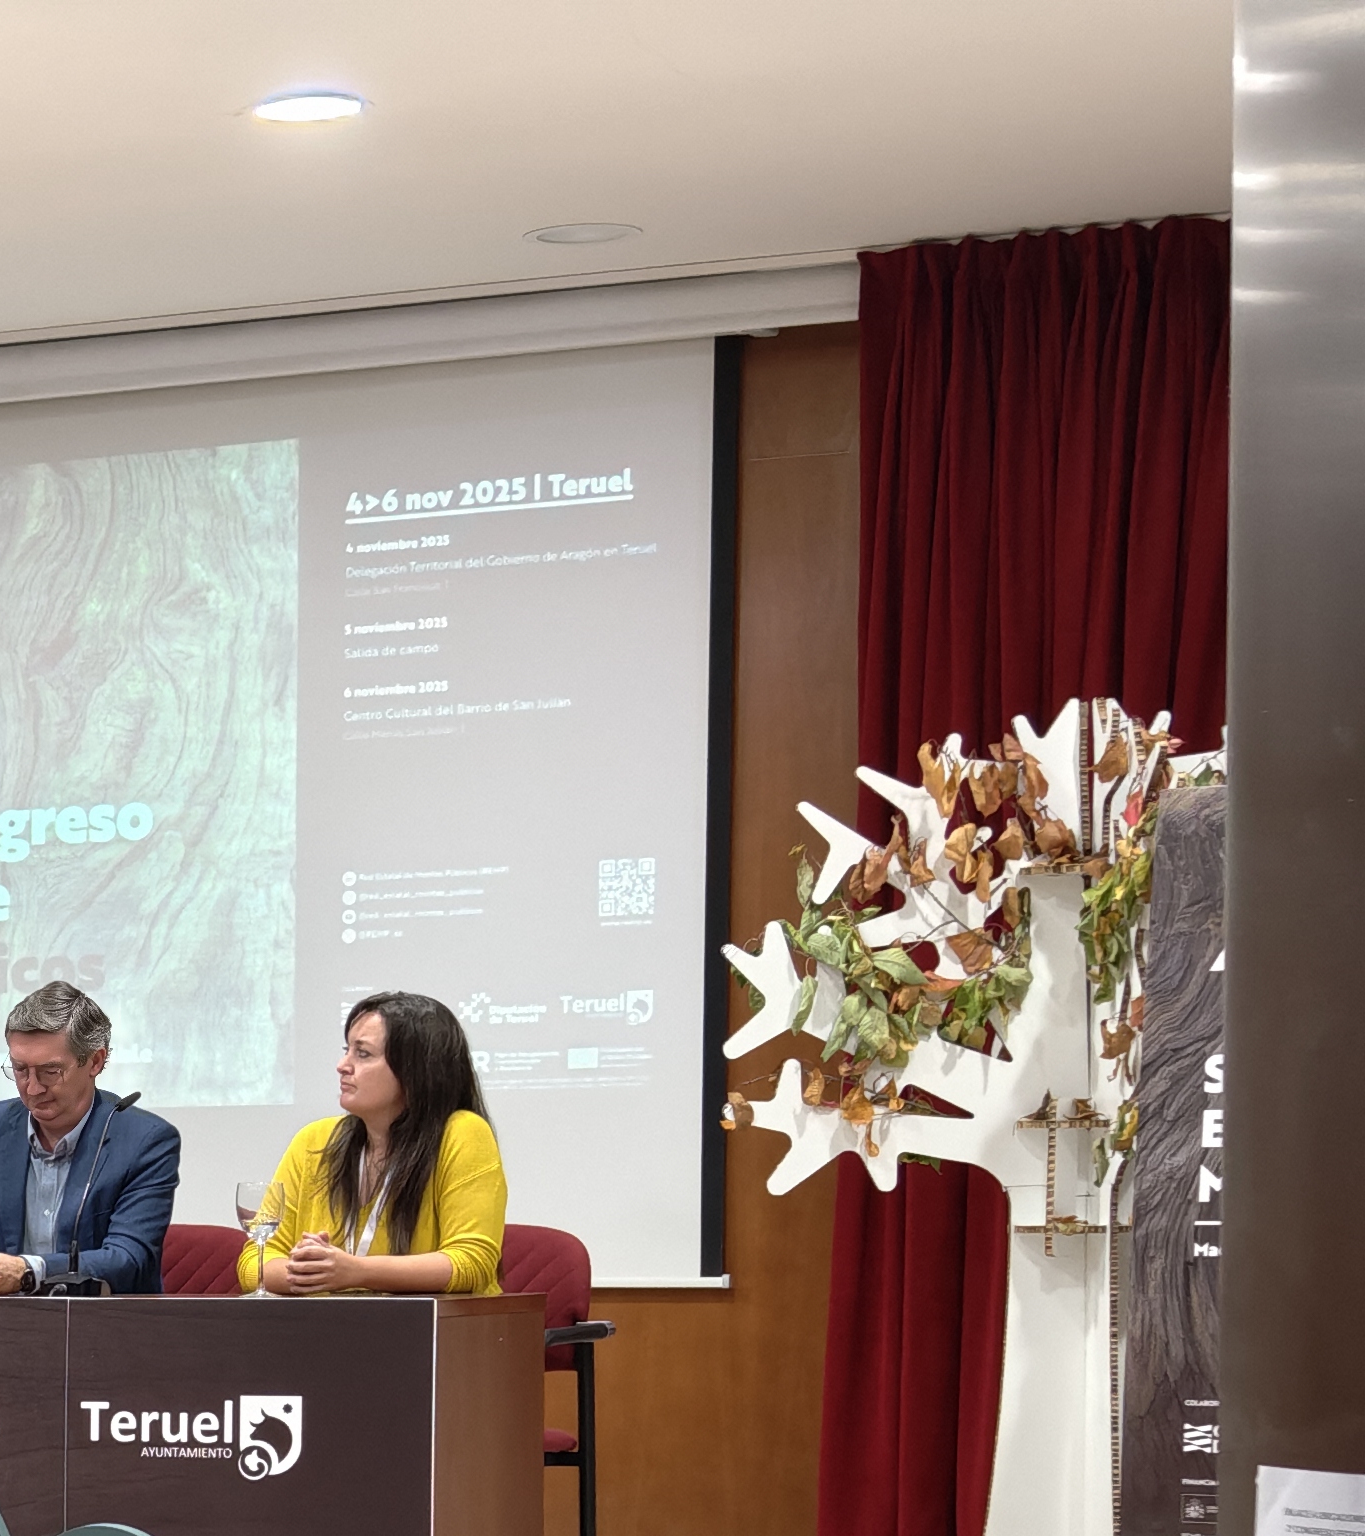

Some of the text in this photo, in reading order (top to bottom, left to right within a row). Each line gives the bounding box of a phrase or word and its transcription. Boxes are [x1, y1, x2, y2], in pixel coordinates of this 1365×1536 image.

[346, 488, 399, 515] 4>6
[405, 488, 454, 512] nov
[459, 477, 527, 507] 2025
[548, 468, 634, 498] Teruel
[356, 539, 418, 554] noviembre
[420, 535, 450, 549] 2025
[354, 621, 416, 635] noviembre
[418, 616, 448, 630] 2025
[354, 684, 416, 697] noviembre
[418, 680, 449, 694] 2025
[560, 993, 625, 1014] Teruel
[79, 1399, 234, 1444] Teruel
[140, 1446, 233, 1459] AYUNTAMIENTO
